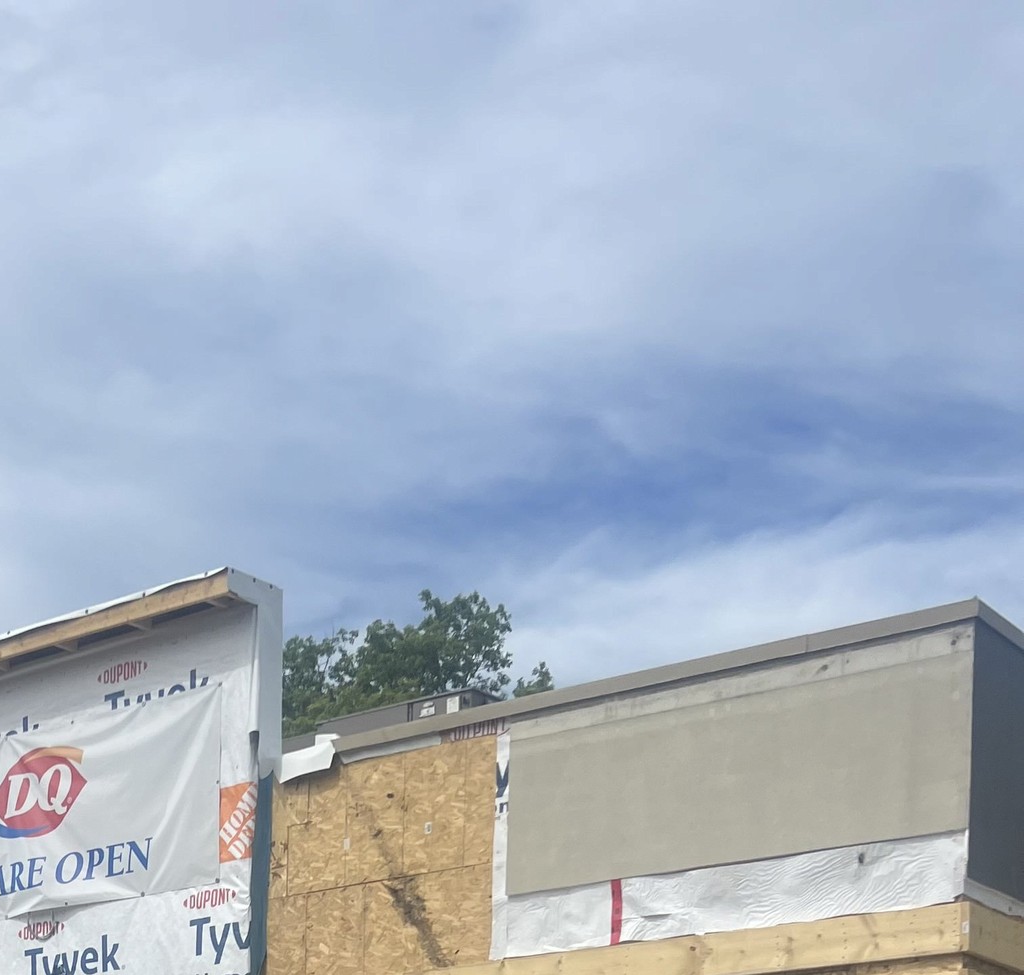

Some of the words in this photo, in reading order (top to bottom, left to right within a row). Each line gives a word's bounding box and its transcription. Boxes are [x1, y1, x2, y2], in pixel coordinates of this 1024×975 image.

[4, 763, 68, 820] DQ
[54, 837, 153, 885] OPEN
[189, 887, 231, 909] DUPONT
